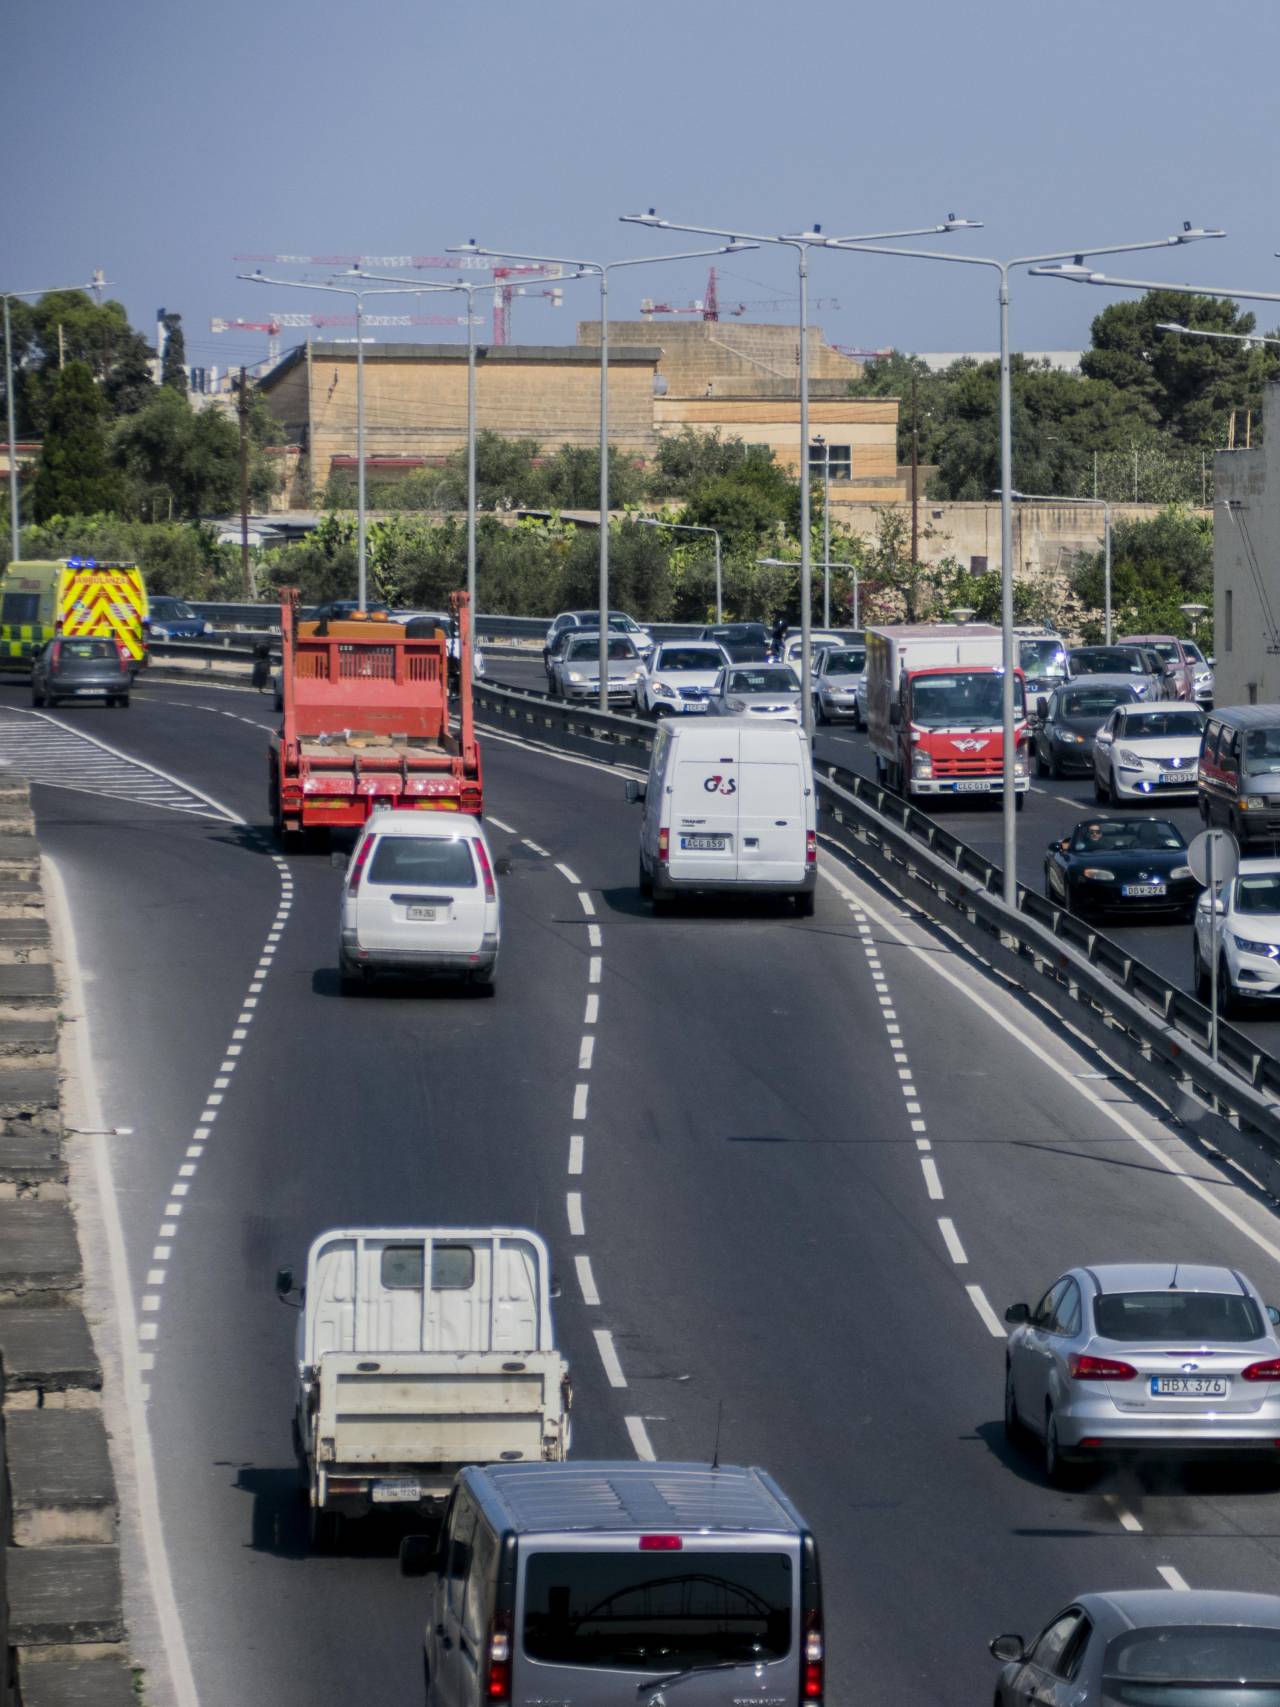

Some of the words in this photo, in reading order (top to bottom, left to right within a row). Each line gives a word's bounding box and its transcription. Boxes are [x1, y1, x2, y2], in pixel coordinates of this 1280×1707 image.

[704, 775, 737, 795] G4S
[1161, 1379, 1189, 1392] HBX
[1195, 1379, 1221, 1392] 376
